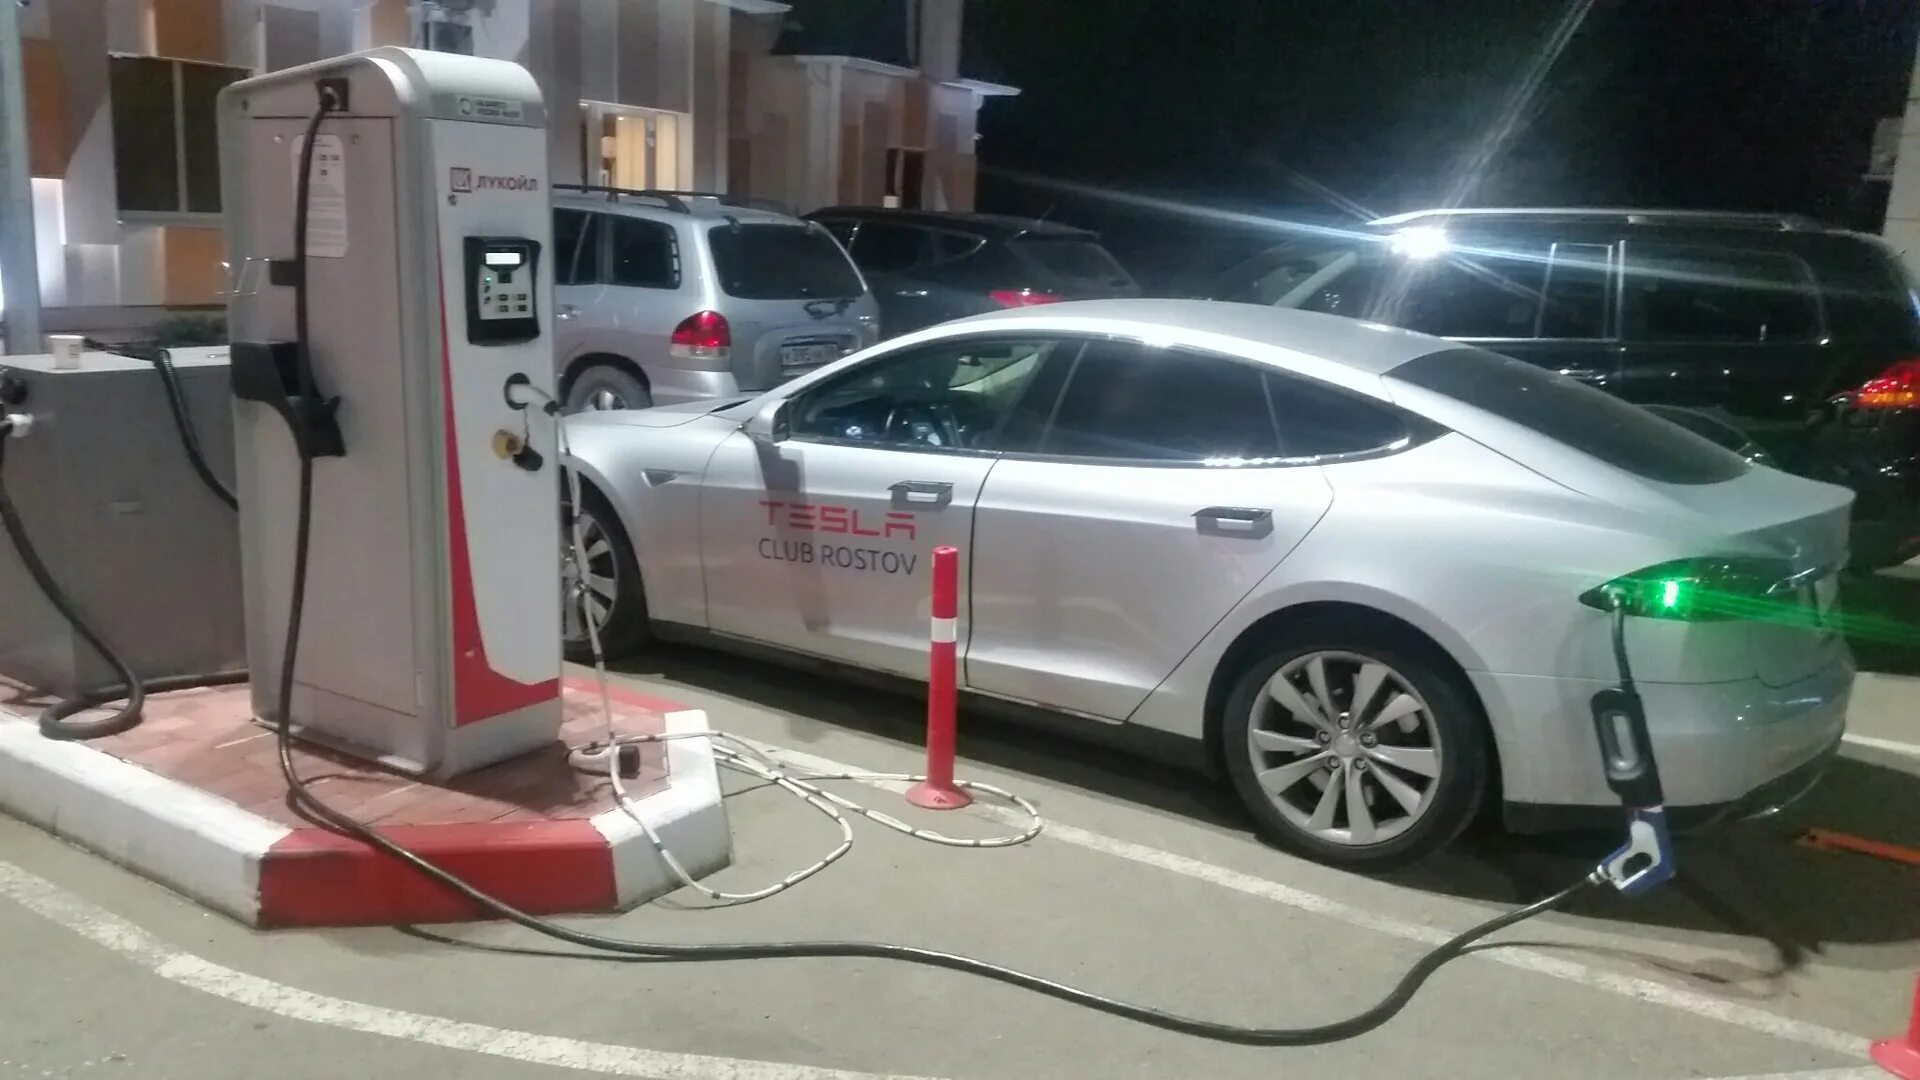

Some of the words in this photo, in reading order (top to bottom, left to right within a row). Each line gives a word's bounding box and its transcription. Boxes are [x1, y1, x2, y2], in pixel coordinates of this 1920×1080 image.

[477, 174, 538, 191] ЛУКОЙЛ
[759, 500, 915, 540] TESLA
[758, 537, 814, 563] CLUB
[821, 544, 917, 576] ROSTOV
